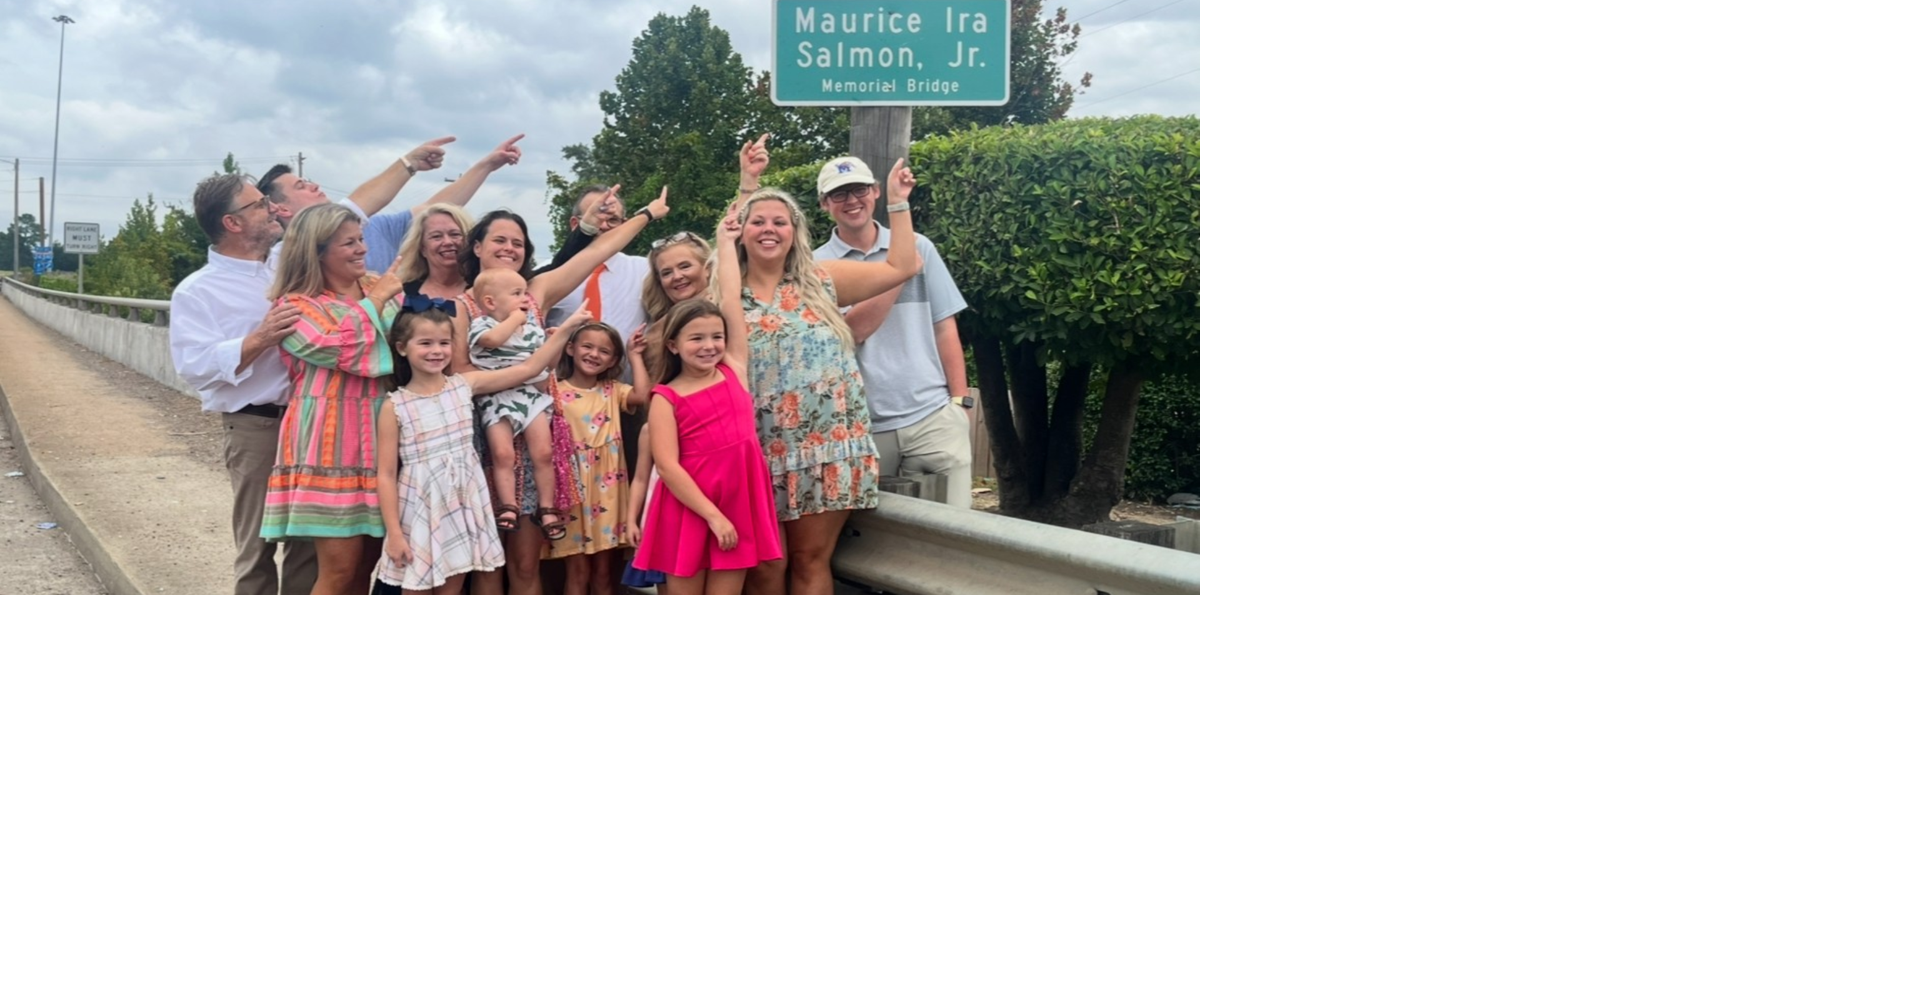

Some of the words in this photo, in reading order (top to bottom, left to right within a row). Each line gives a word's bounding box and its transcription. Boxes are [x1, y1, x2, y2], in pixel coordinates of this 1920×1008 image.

[795, 7, 921, 33] Maurice
[946, 7, 988, 33] Ira
[797, 41, 924, 71] Salmon,
[948, 41, 986, 68] Jr.
[822, 79, 896, 92] Memorial
[907, 79, 960, 95] Bridge
